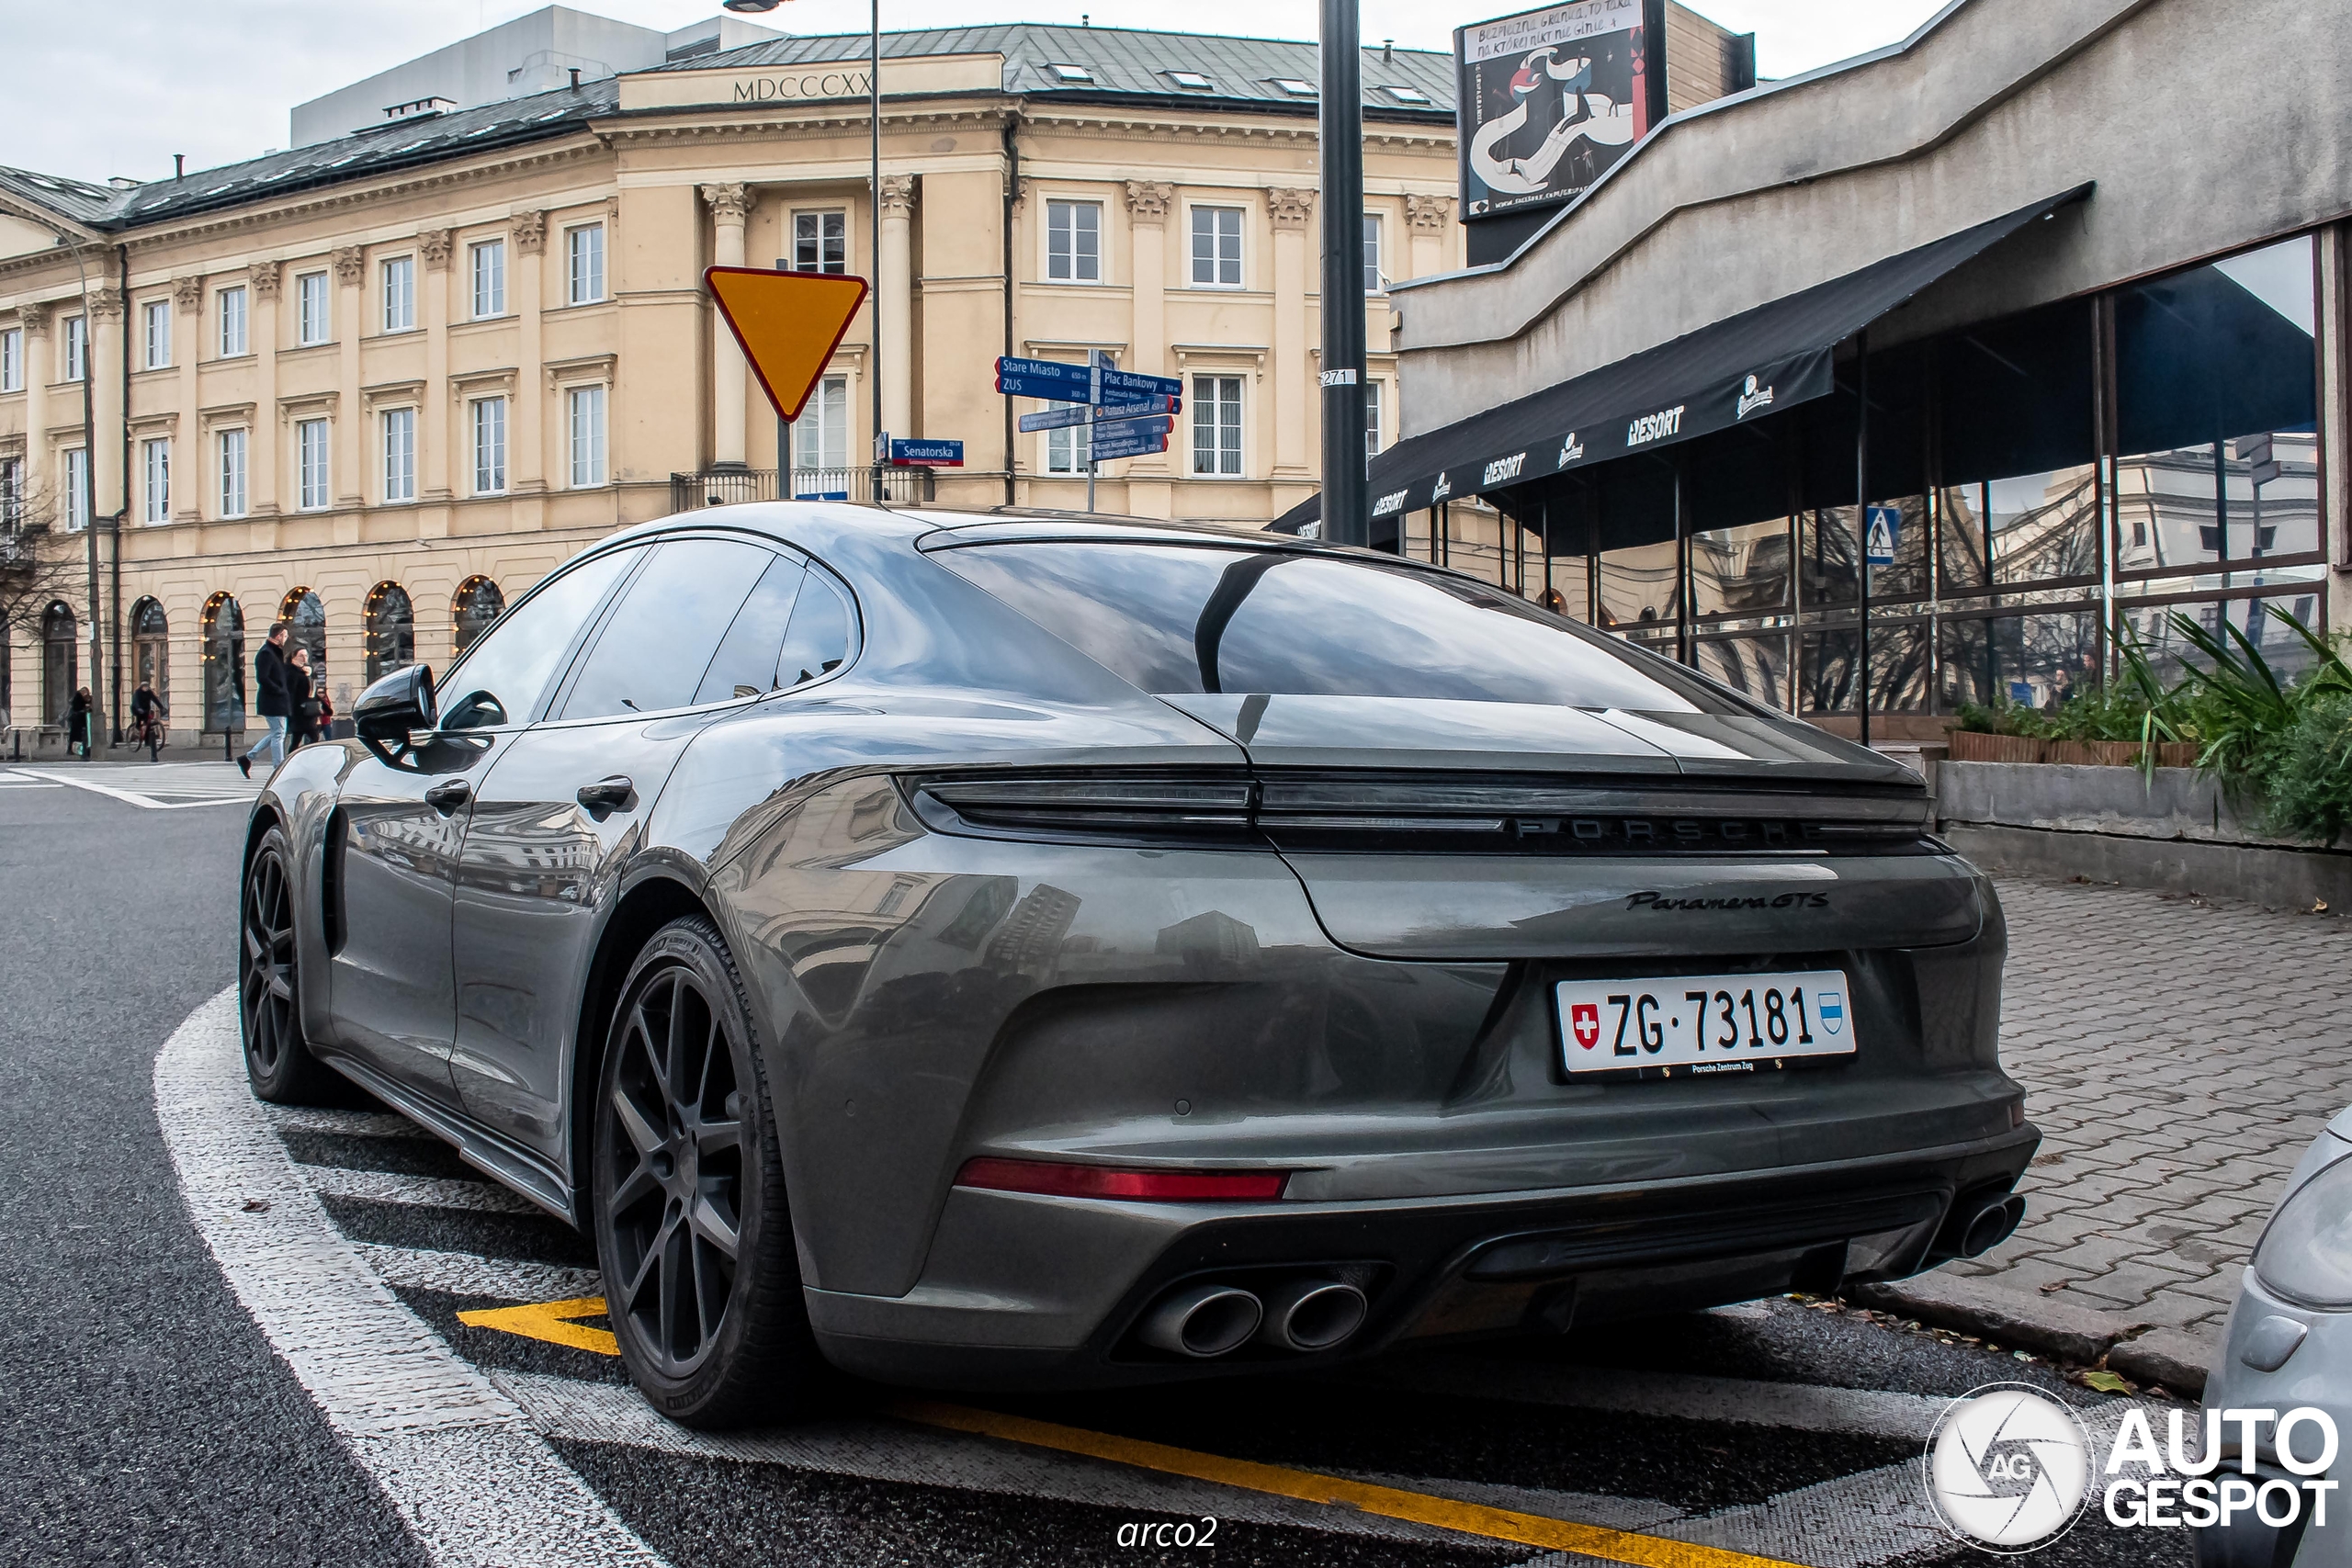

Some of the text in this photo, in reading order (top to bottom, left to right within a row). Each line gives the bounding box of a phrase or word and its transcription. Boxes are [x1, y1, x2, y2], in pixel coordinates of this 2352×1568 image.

[1003, 359, 1027, 374] Stare
[1030, 363, 1060, 378] Miasto
[1003, 378, 1022, 391] ZUS
[1104, 372, 1121, 385] Plac
[1123, 375, 1158, 392] Bankowy
[1104, 406, 1125, 416] Ratusz
[1125, 400, 1150, 413] Arsenal
[1626, 404, 1685, 446] RESORT
[904, 446, 954, 457] Senatorska
[1482, 451, 1527, 486] RESORT
[1372, 489, 1408, 516] RESORT
[1515, 818, 1822, 841] PORSCHE
[1625, 891, 1830, 910] Panamera GTS
[1691, 1061, 1754, 1074] Porsche Zentrum Zug
